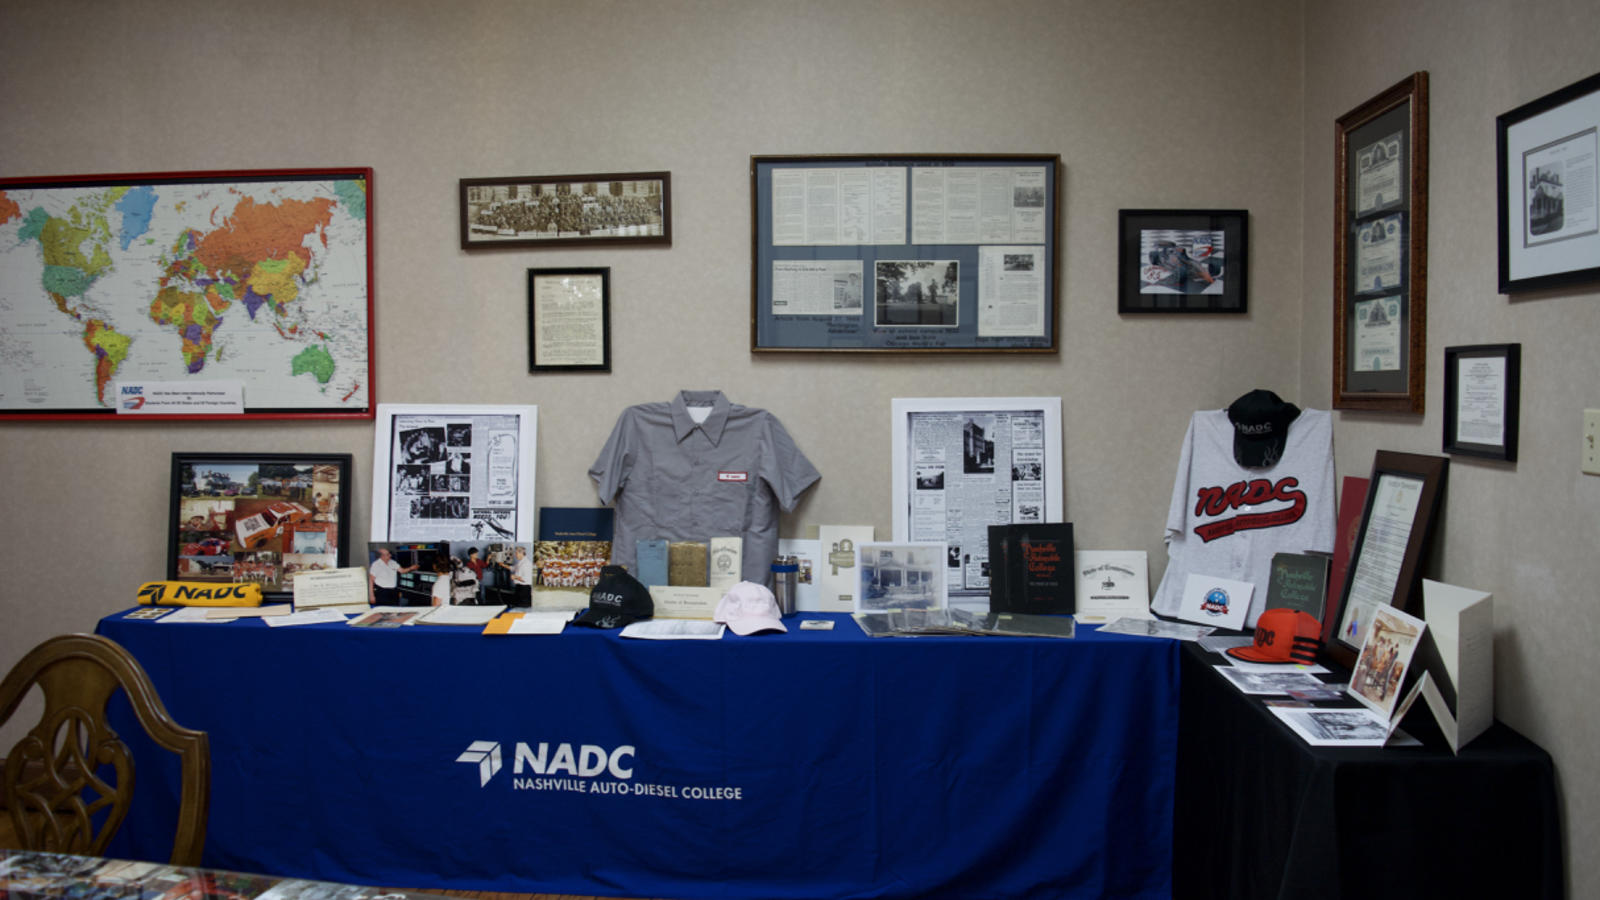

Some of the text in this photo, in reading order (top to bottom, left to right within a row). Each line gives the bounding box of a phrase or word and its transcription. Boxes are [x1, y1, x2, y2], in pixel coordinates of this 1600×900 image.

[1194, 476, 1299, 517] NADC
[174, 584, 251, 600] NADC
[513, 742, 635, 779] NADC
[513, 778, 743, 801] NASHVILLE AUTO-DIESEL COLLEGE
